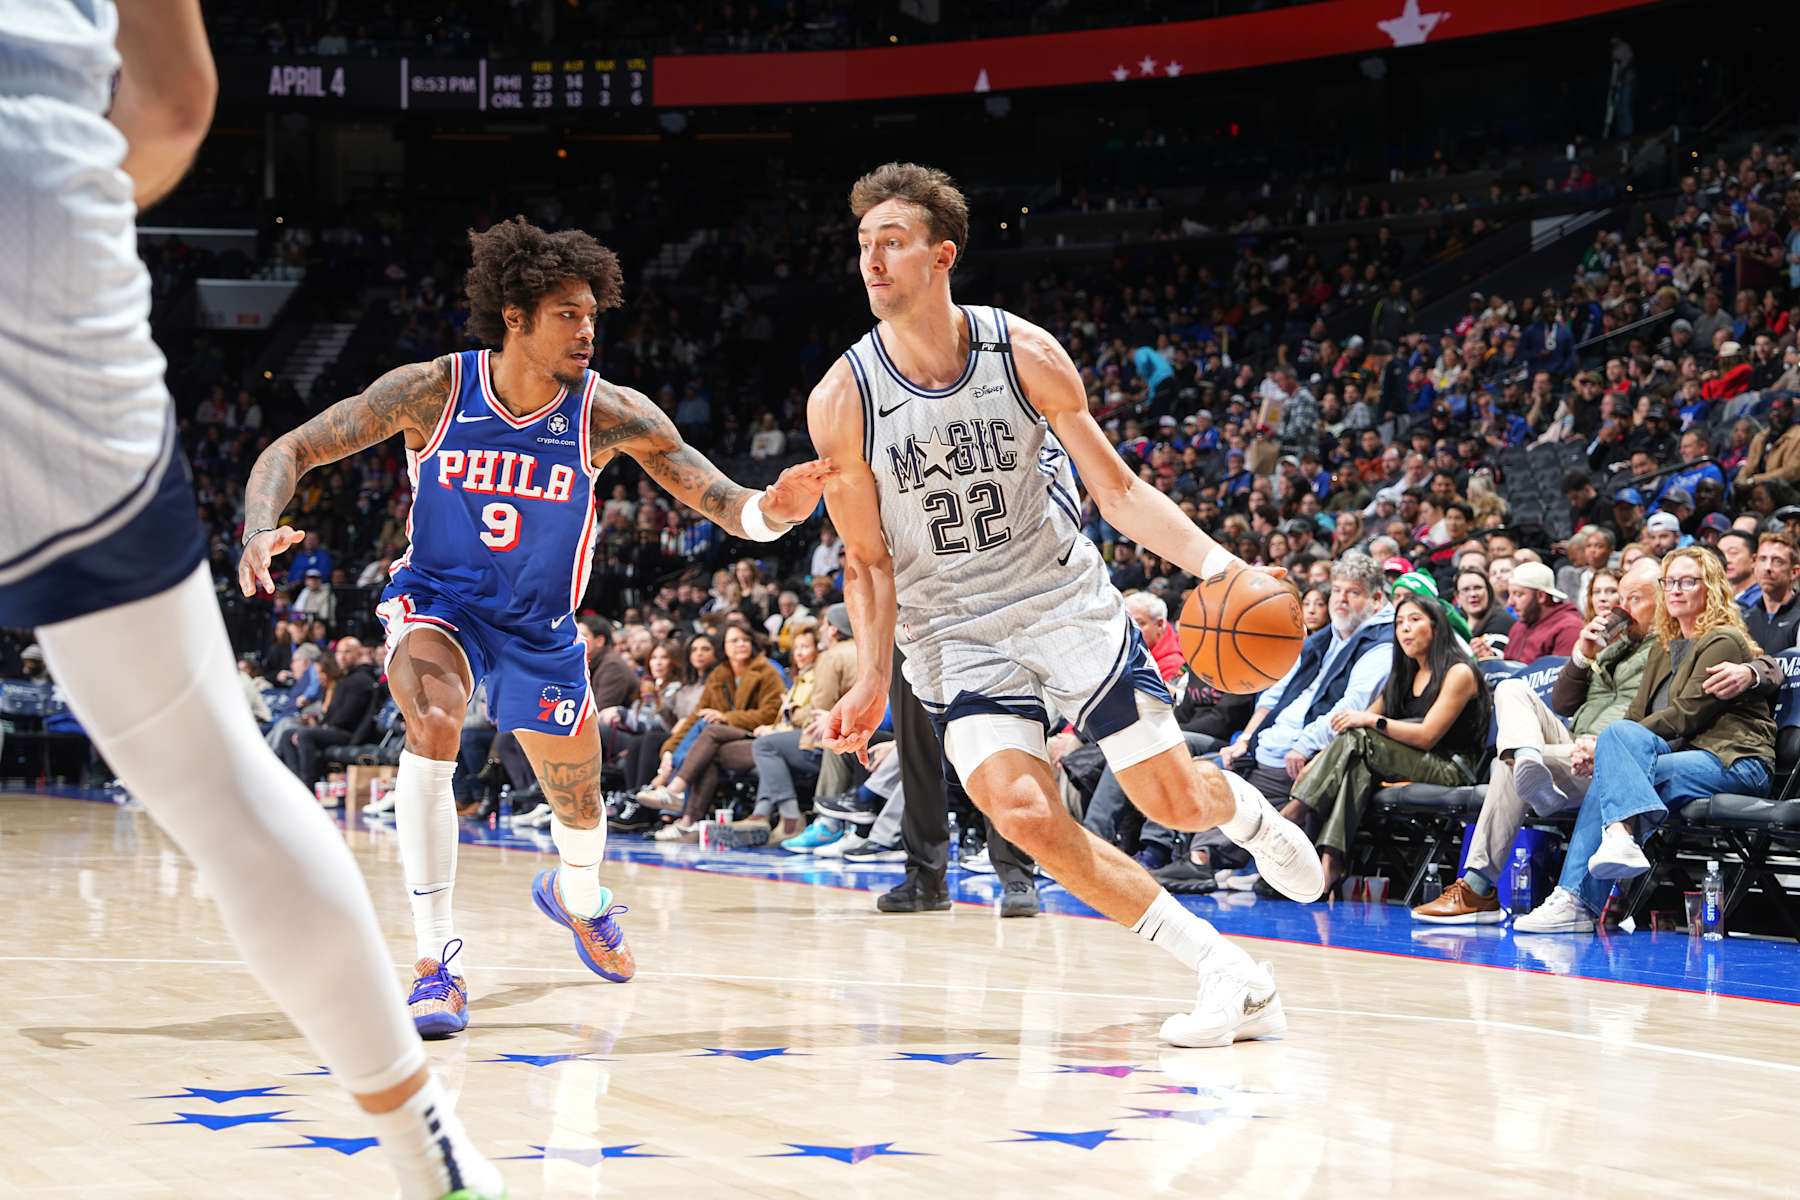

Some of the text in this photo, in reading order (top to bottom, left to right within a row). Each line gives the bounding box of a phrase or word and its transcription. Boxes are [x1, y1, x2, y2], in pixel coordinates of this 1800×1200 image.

[268, 65, 346, 97] APRIL 4
[411, 76, 476, 93] 8:53 PM
[493, 72, 642, 91] PHI 23 14 1 3
[491, 92, 523, 108] ORL
[532, 92, 553, 108] 23
[599, 90, 610, 106] 3
[631, 90, 643, 106] 6
[981, 343, 996, 351] PW
[969, 385, 1004, 399] Disney
[536, 437, 576, 447] crypto.com
[437, 449, 577, 503] PHILA
[479, 502, 522, 552] 9
[922, 479, 1012, 556] 22
[537, 696, 576, 726] 76
[1706, 891, 1716, 922] smart
